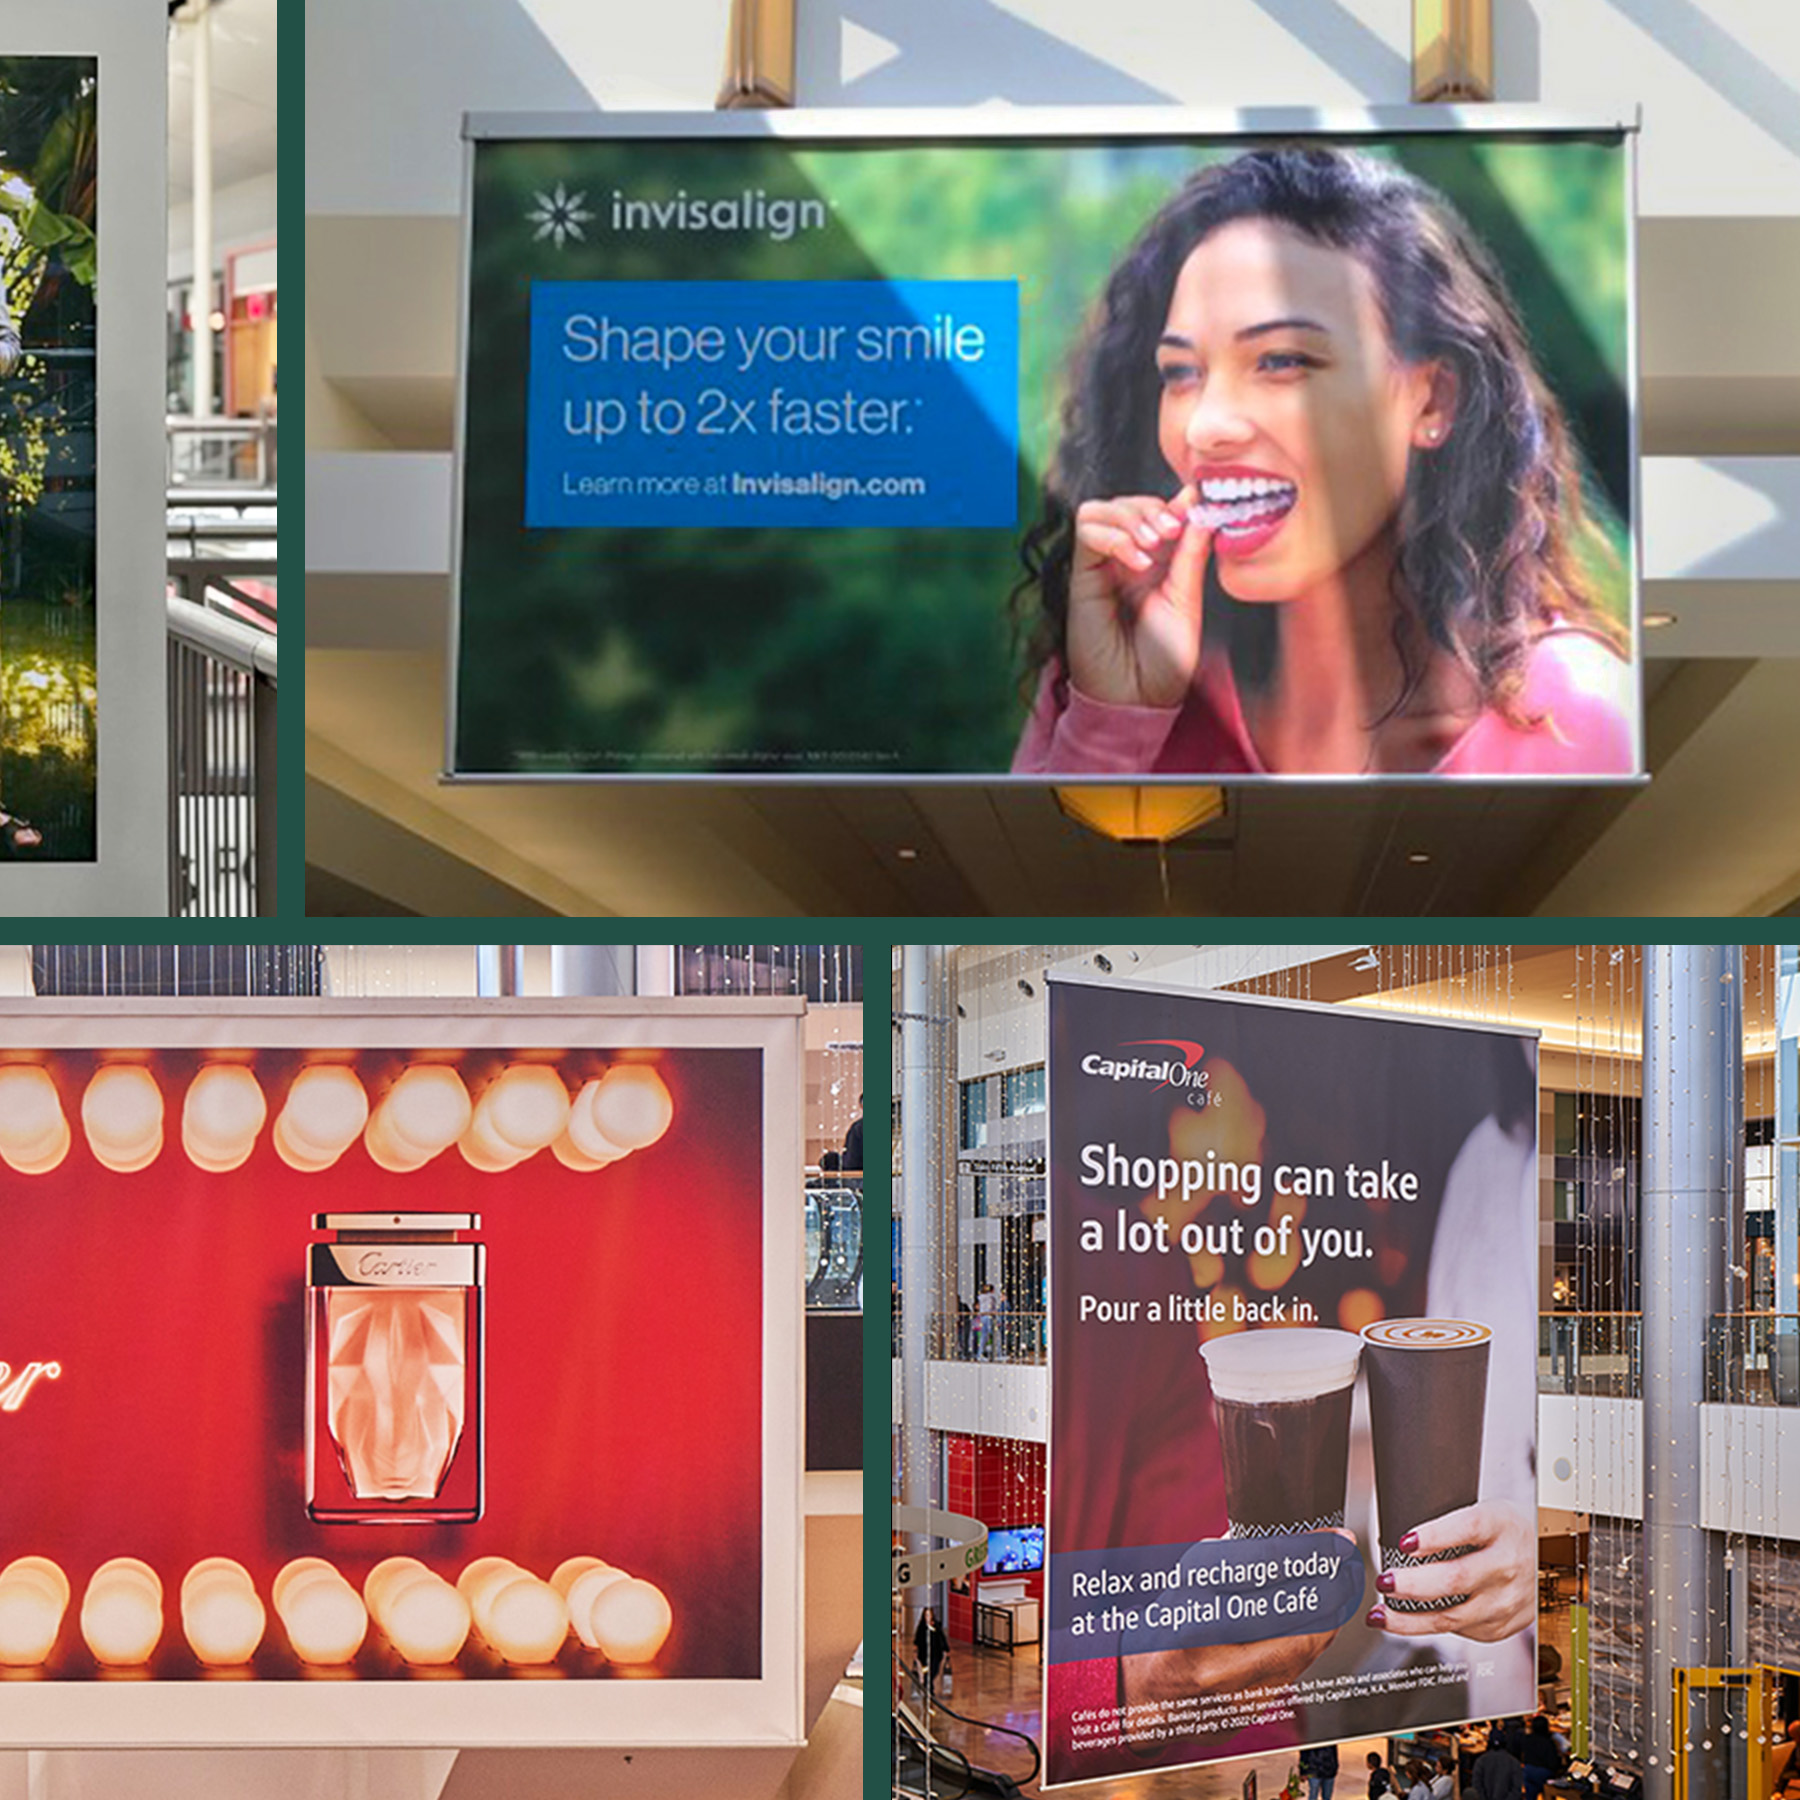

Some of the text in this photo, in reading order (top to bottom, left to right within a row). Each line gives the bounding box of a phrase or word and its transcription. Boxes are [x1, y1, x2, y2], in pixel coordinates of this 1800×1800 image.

[612, 190, 826, 241] invisalign
[562, 313, 986, 371] Shape your smile
[564, 399, 626, 443] up
[638, 391, 688, 435] to
[696, 387, 759, 435] 2x
[562, 472, 926, 501] Learn more at Invisalign.com
[1187, 1090, 1223, 1107] café
[1080, 1143, 1419, 1205] Shopping can take
[1080, 1209, 1374, 1267] a lot out of you.
[1080, 1295, 1320, 1323] Pour a little back in.
[1072, 1551, 1342, 1598] Relax and recharge today
[1071, 1585, 1320, 1636] at the Capital One Café
